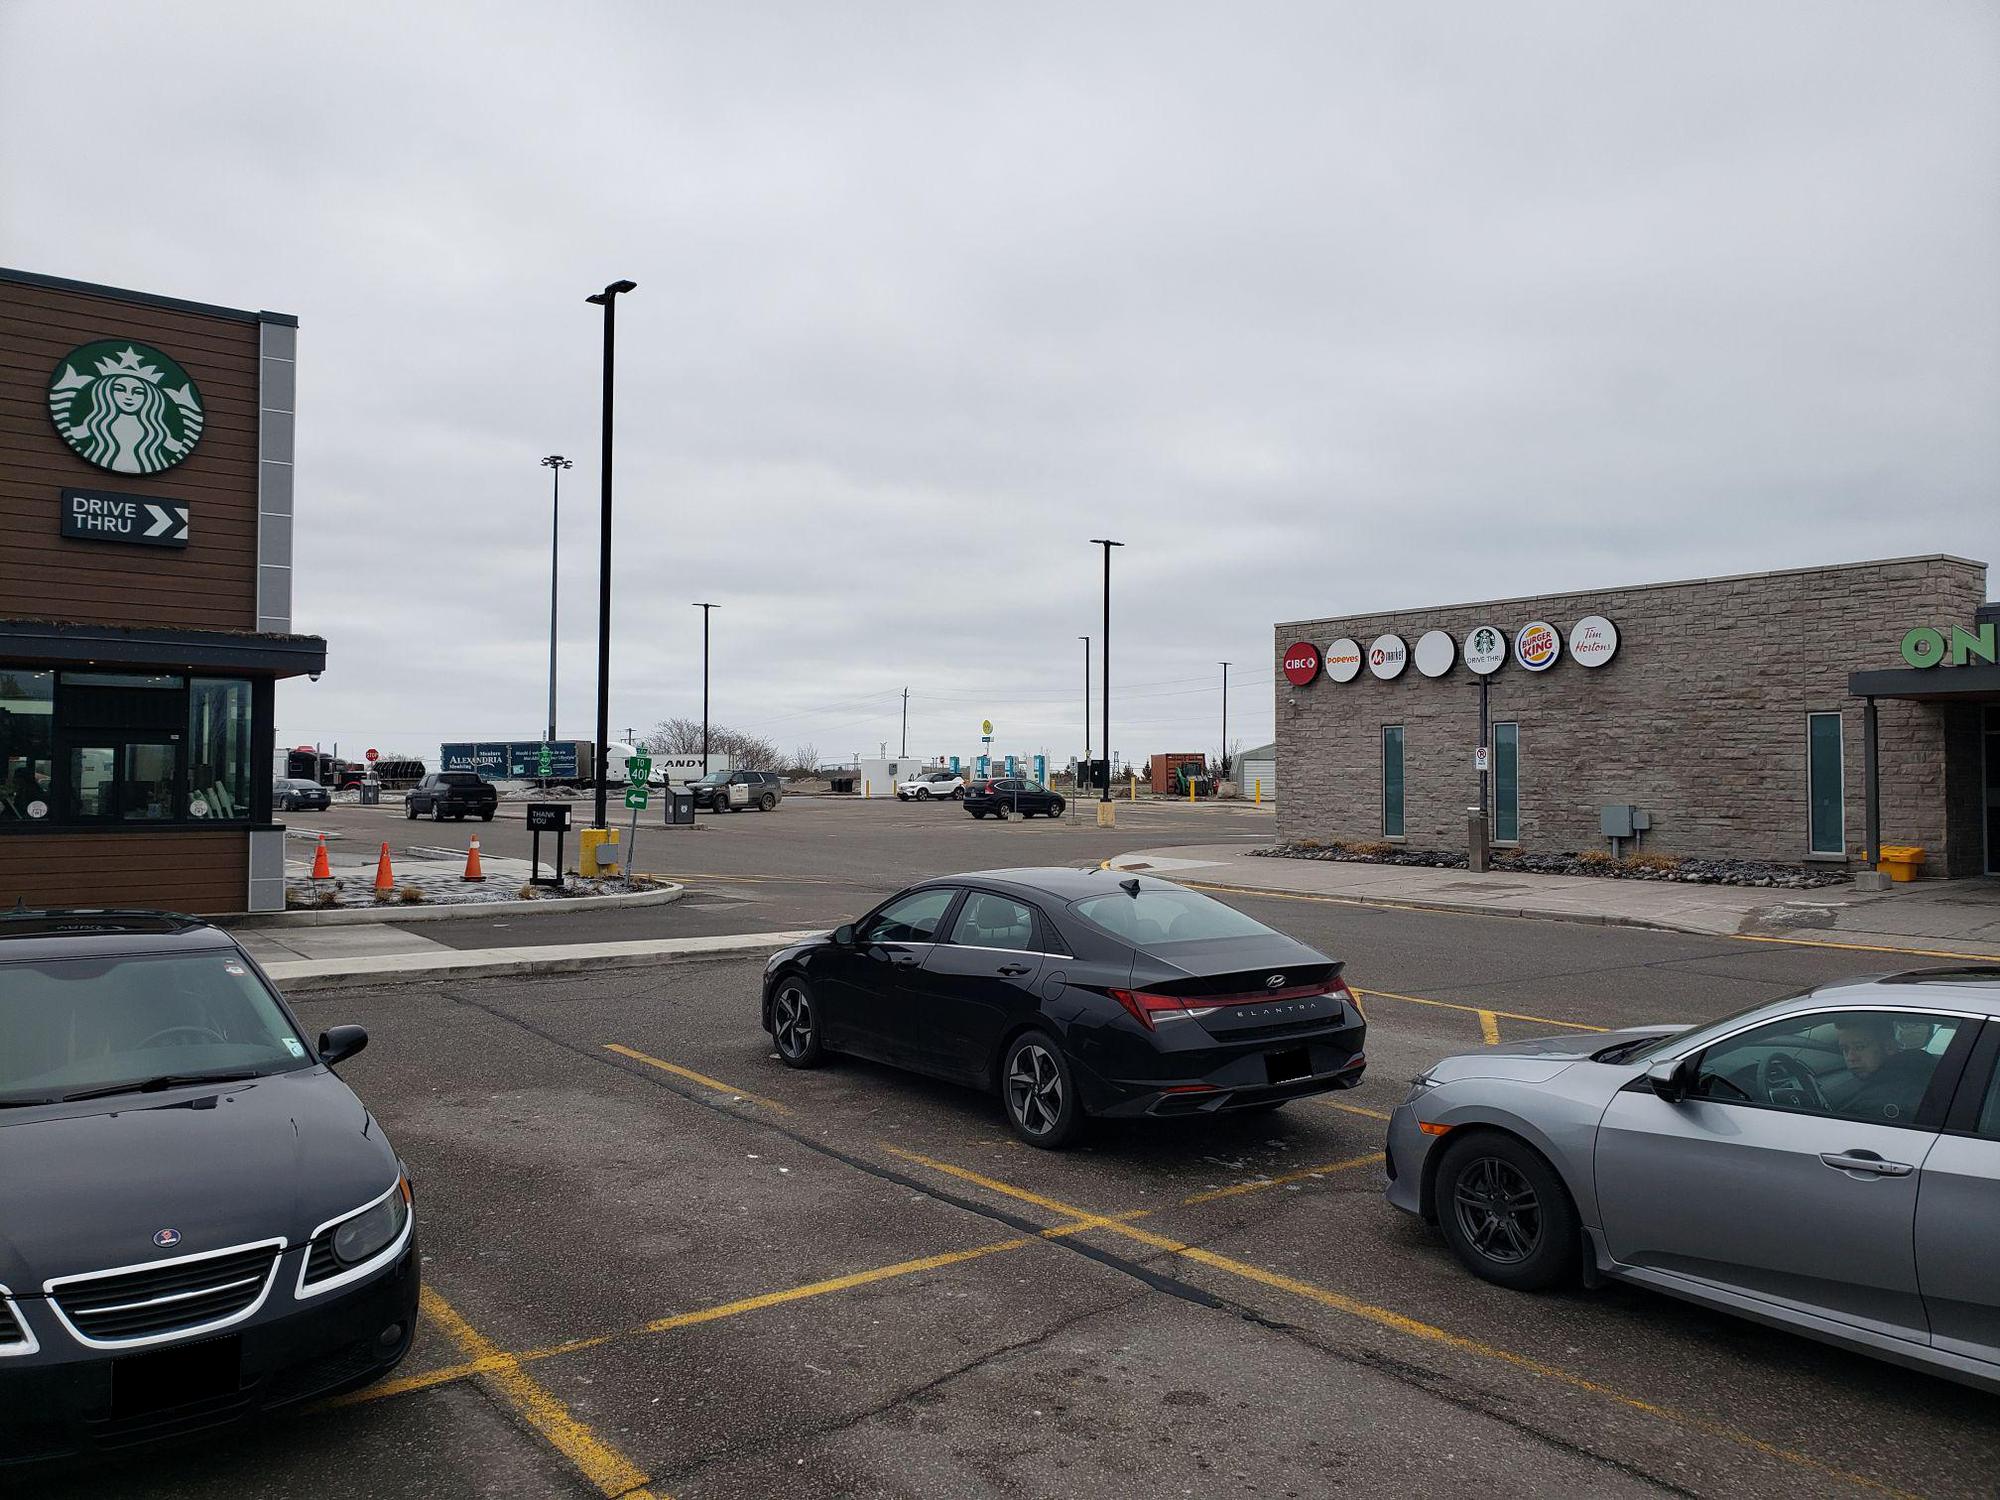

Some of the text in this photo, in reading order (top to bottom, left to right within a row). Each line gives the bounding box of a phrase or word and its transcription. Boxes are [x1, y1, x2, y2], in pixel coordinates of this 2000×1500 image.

[72, 497, 137, 518] DRIVE
[73, 513, 131, 533] THRU
[1522, 631, 1552, 647] BURGER
[1584, 626, 1602, 640] Tim
[1523, 639, 1553, 658] KING
[1575, 641, 1611, 653] Hortons
[1901, 623, 1995, 669] ON
[1285, 658, 1306, 669] CIBC
[1466, 655, 1503, 664] DRIVE THRU
[637, 759, 645, 767] TO
[664, 759, 705, 768] ANDY
[631, 768, 648, 780] 401
[1237, 1003, 1316, 1017] ELANTRA
